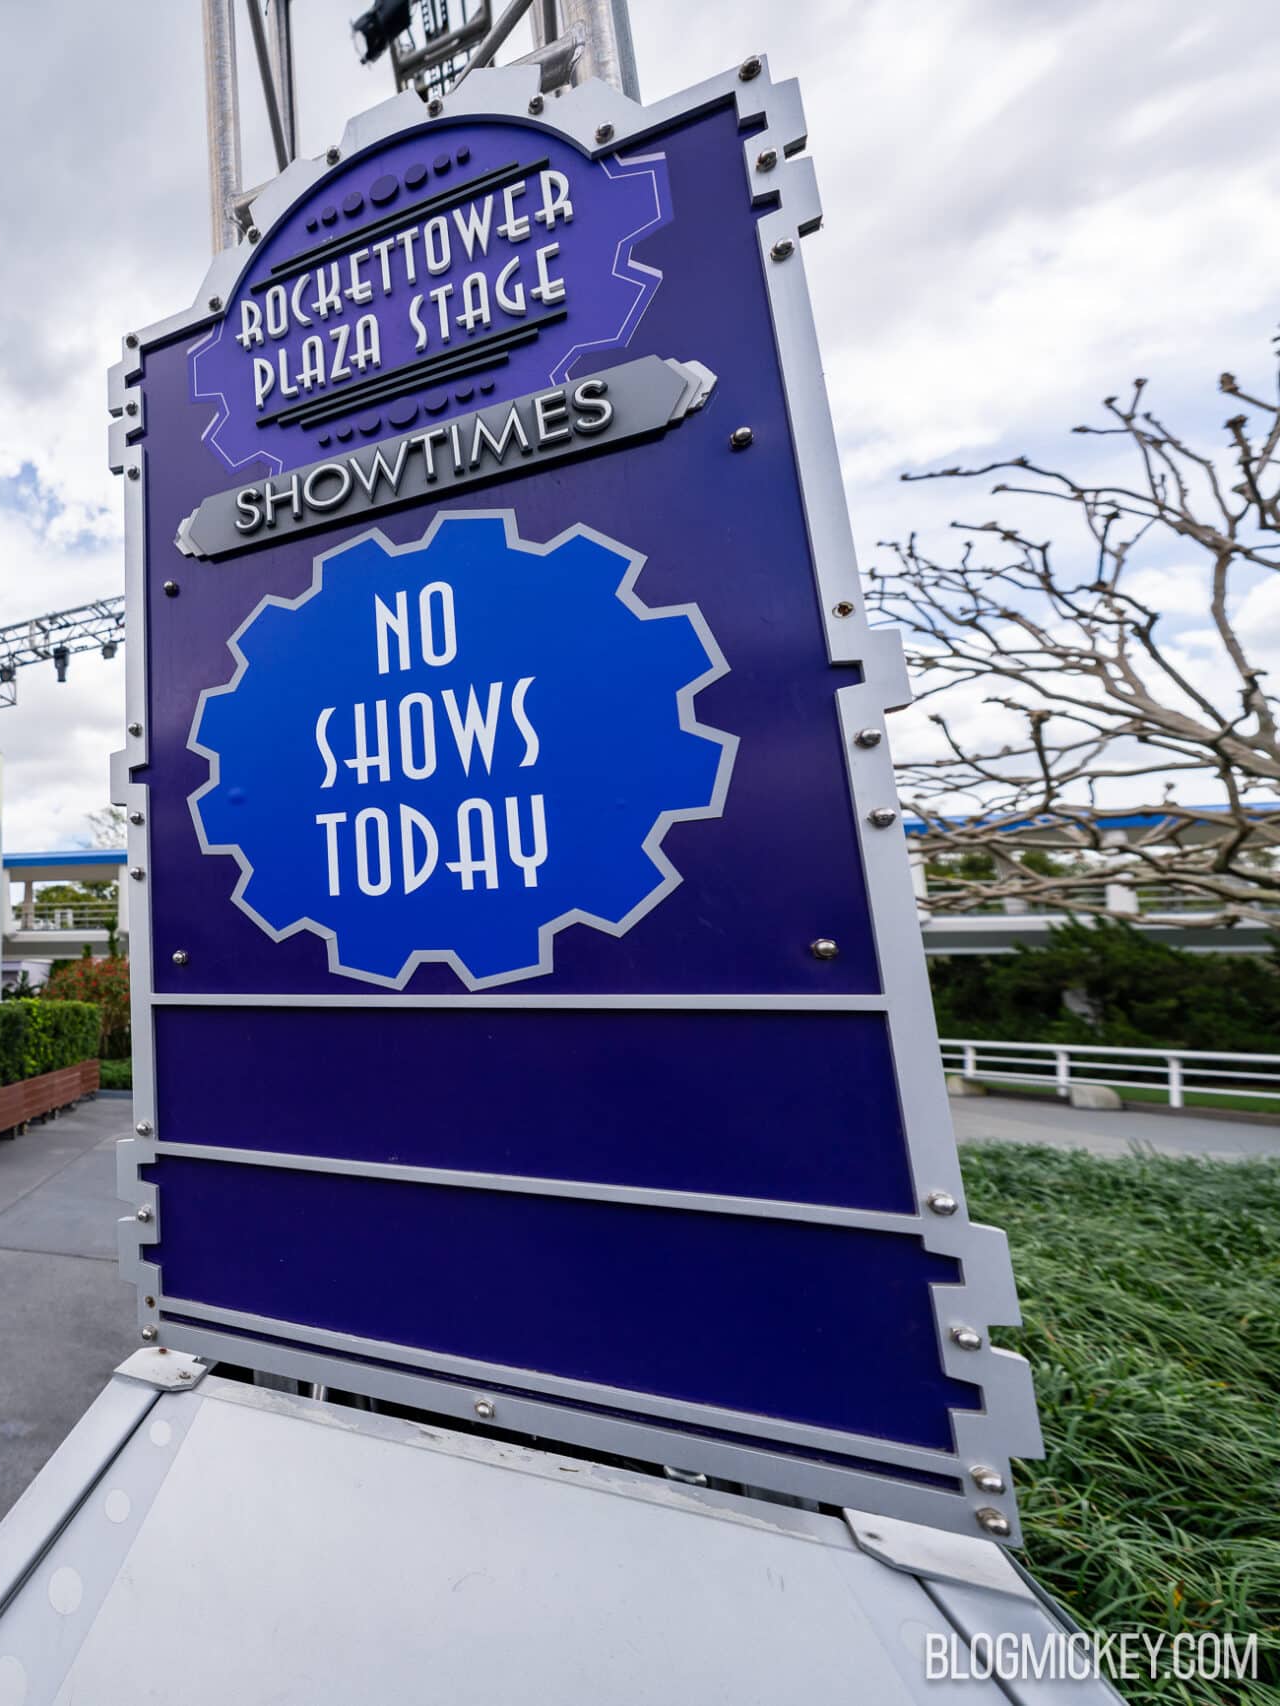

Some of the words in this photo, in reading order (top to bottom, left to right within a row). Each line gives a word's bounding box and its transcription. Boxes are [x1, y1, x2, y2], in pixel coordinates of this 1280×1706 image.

[235, 169, 575, 352] ROCKETTOWER
[253, 313, 382, 411] PLAZA
[408, 242, 567, 353] STAGE
[233, 378, 615, 537] SHOWTIMES
[374, 581, 458, 675] NO
[315, 676, 540, 788] SHOWS
[315, 794, 549, 897] TODAY
